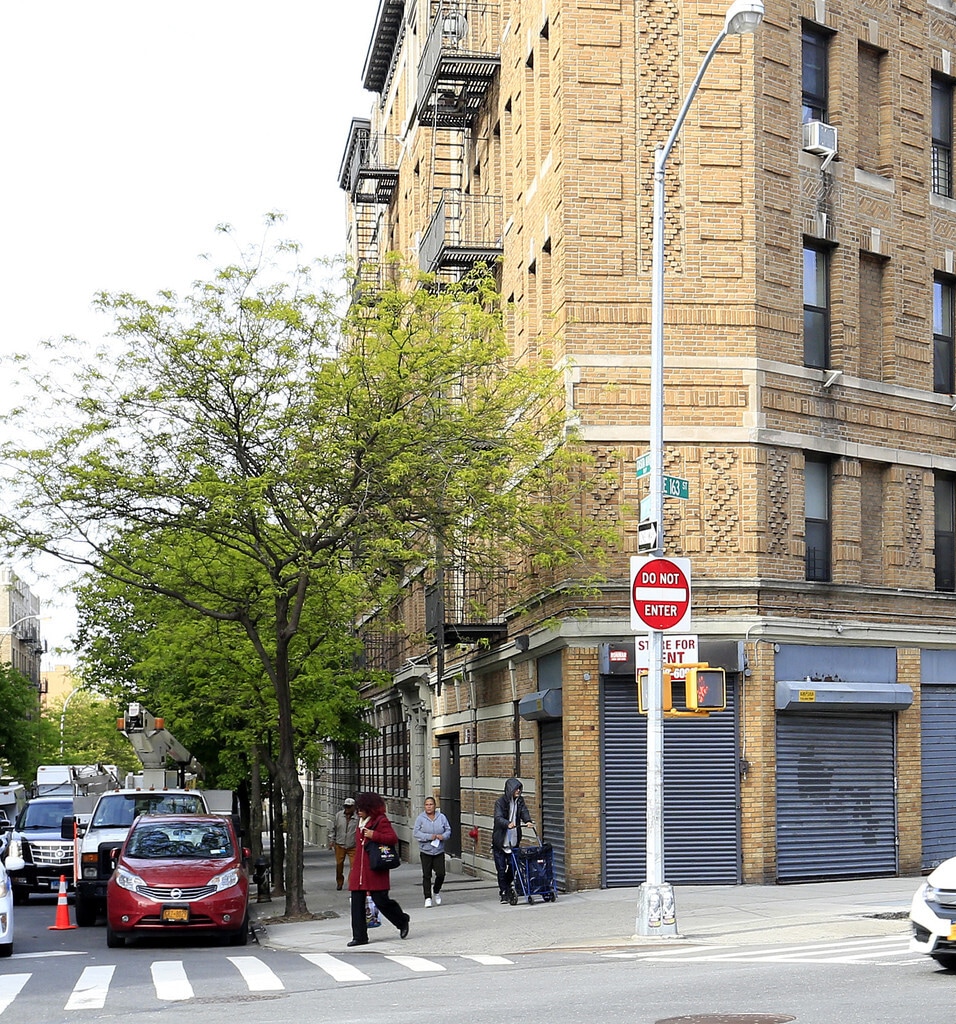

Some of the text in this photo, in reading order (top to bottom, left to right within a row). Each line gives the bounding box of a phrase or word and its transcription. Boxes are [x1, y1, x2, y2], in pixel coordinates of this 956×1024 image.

[669, 478, 680, 496] 163
[682, 481, 688, 491] ST
[642, 572, 679, 585] DO NOT
[644, 604, 677, 617] ENTER
[675, 639, 695, 650] FOR
[662, 652, 685, 664] ENT
